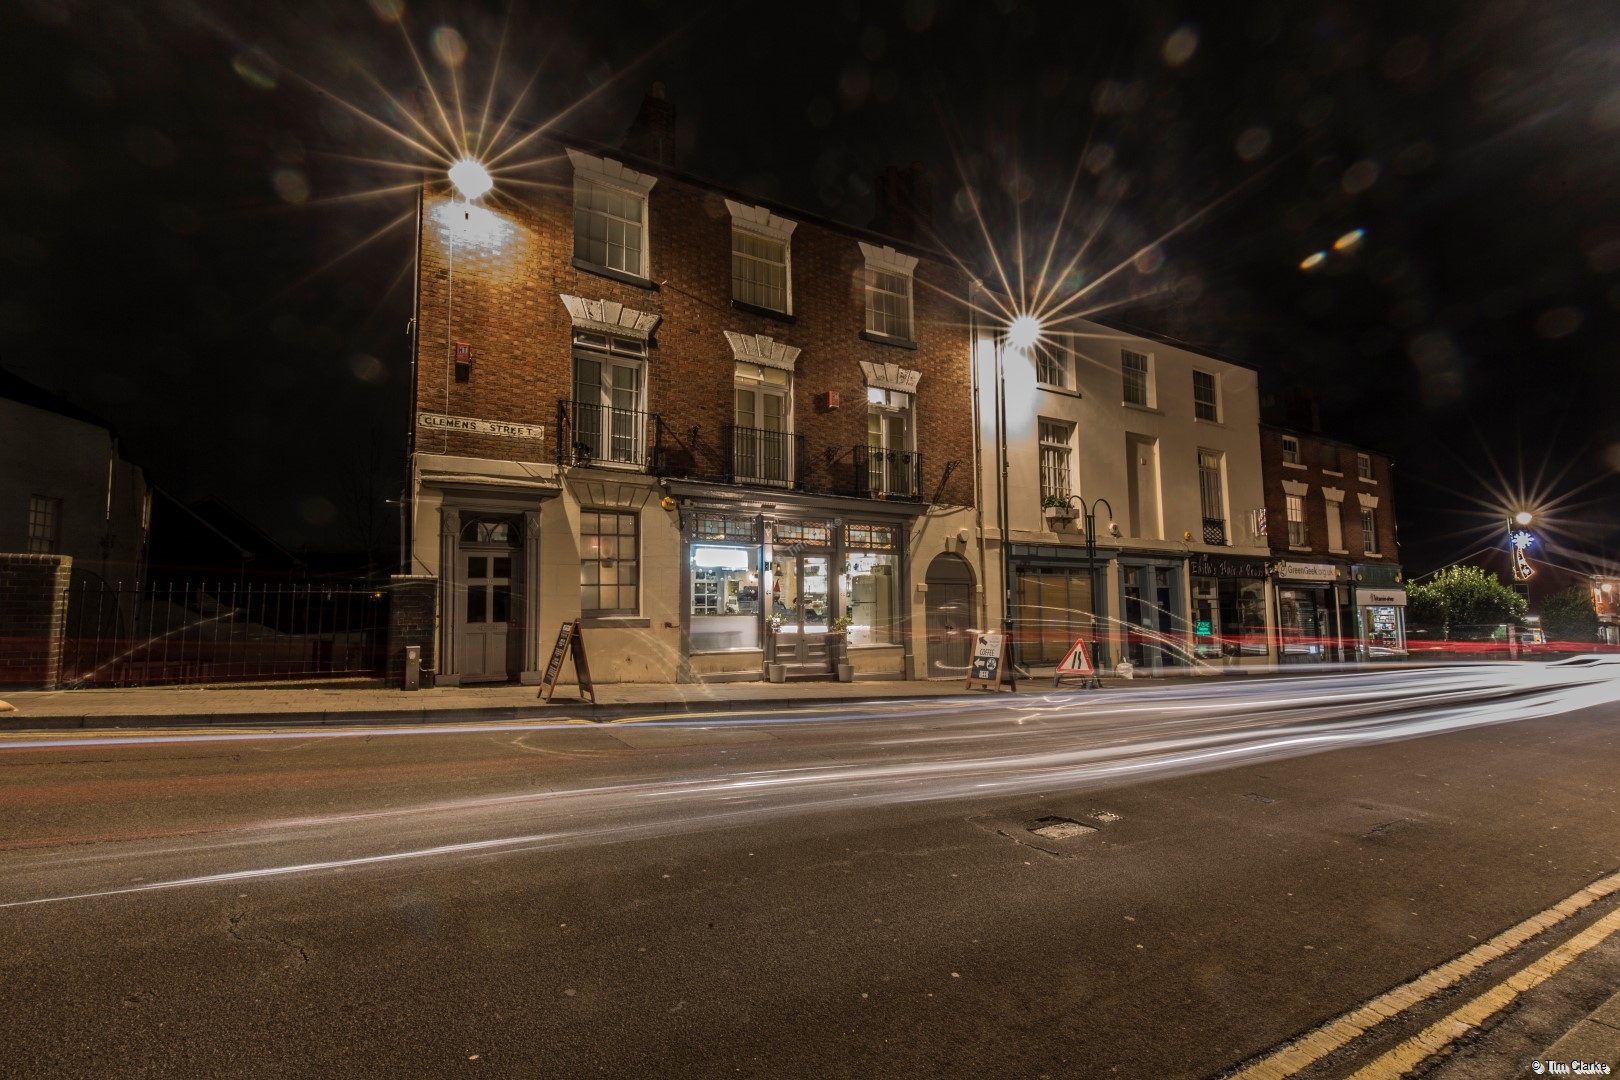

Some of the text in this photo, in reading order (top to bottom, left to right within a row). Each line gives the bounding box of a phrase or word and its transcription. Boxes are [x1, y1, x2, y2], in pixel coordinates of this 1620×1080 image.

[424, 417, 533, 436] CLEMENS STREET
[980, 648, 995, 656] COFFEE
